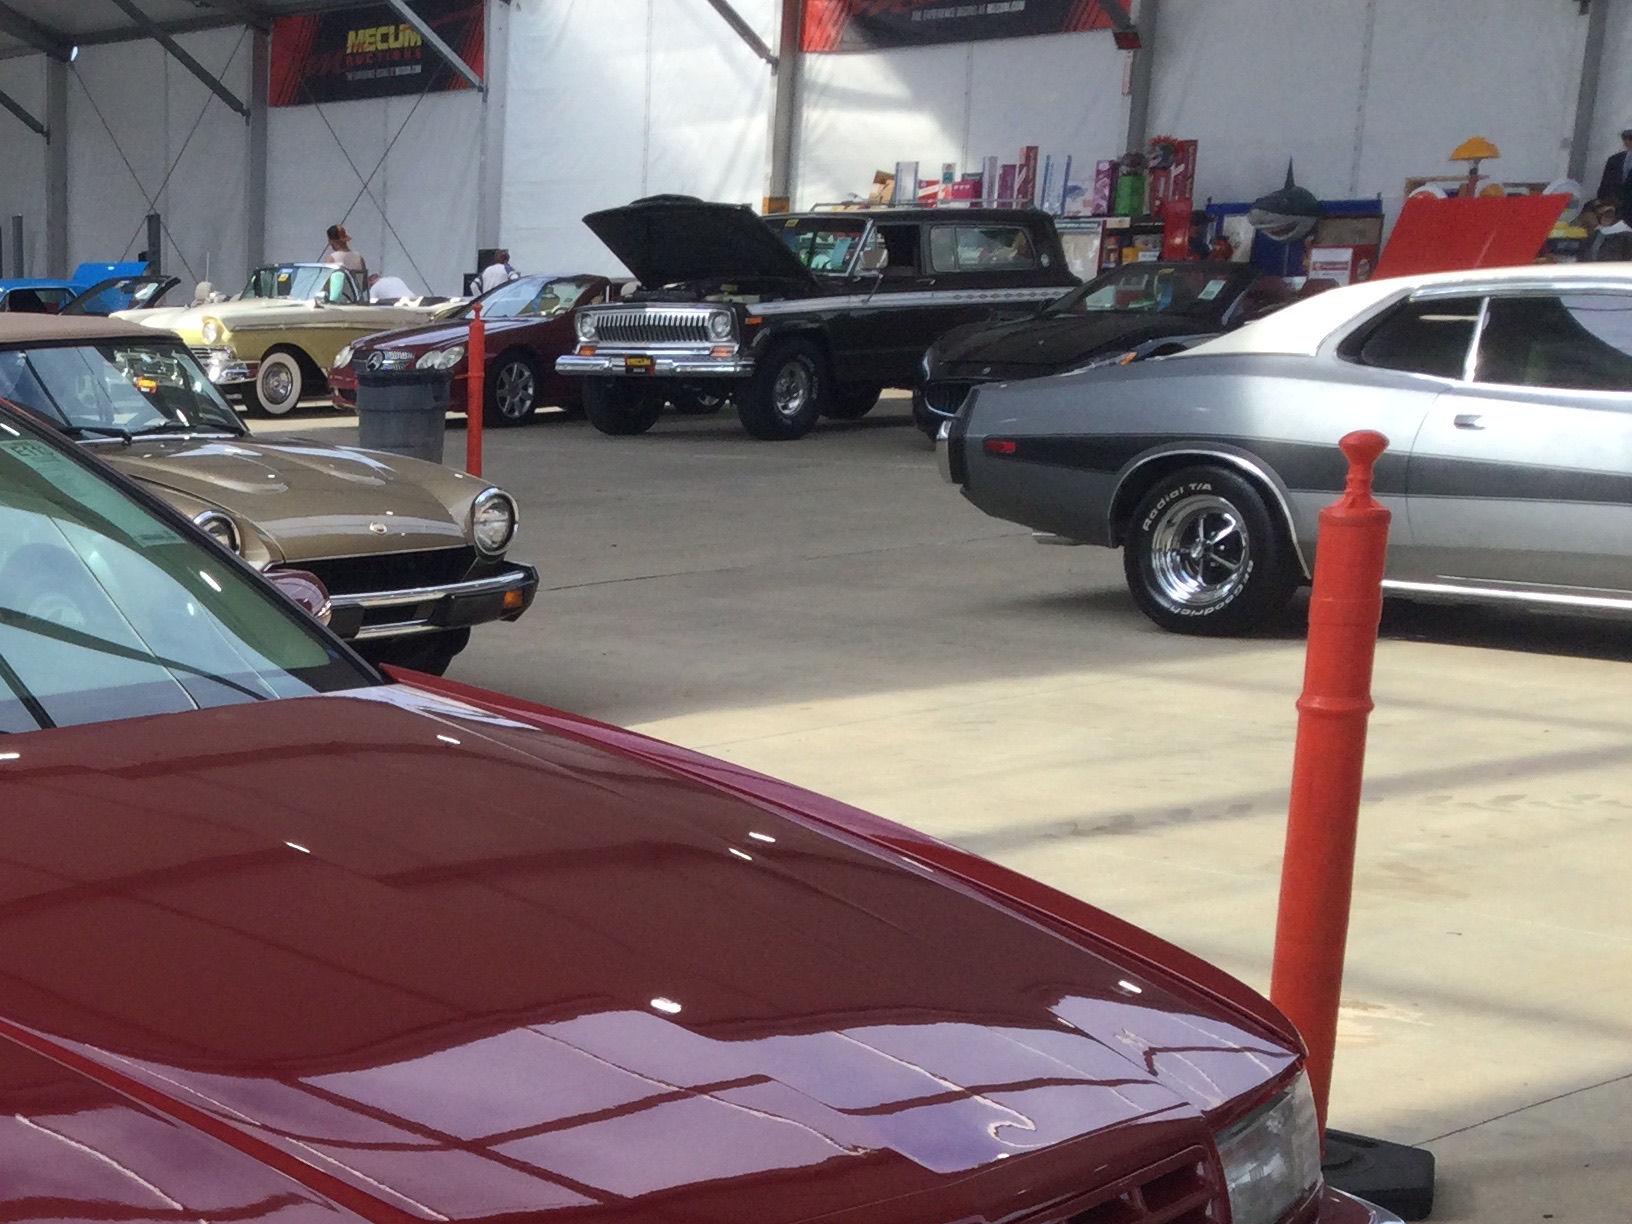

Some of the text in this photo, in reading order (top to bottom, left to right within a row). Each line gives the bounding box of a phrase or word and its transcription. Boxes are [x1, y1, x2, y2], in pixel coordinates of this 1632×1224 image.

[346, 23, 422, 54] MECUM
[1142, 482, 1212, 532] Radial T/A
